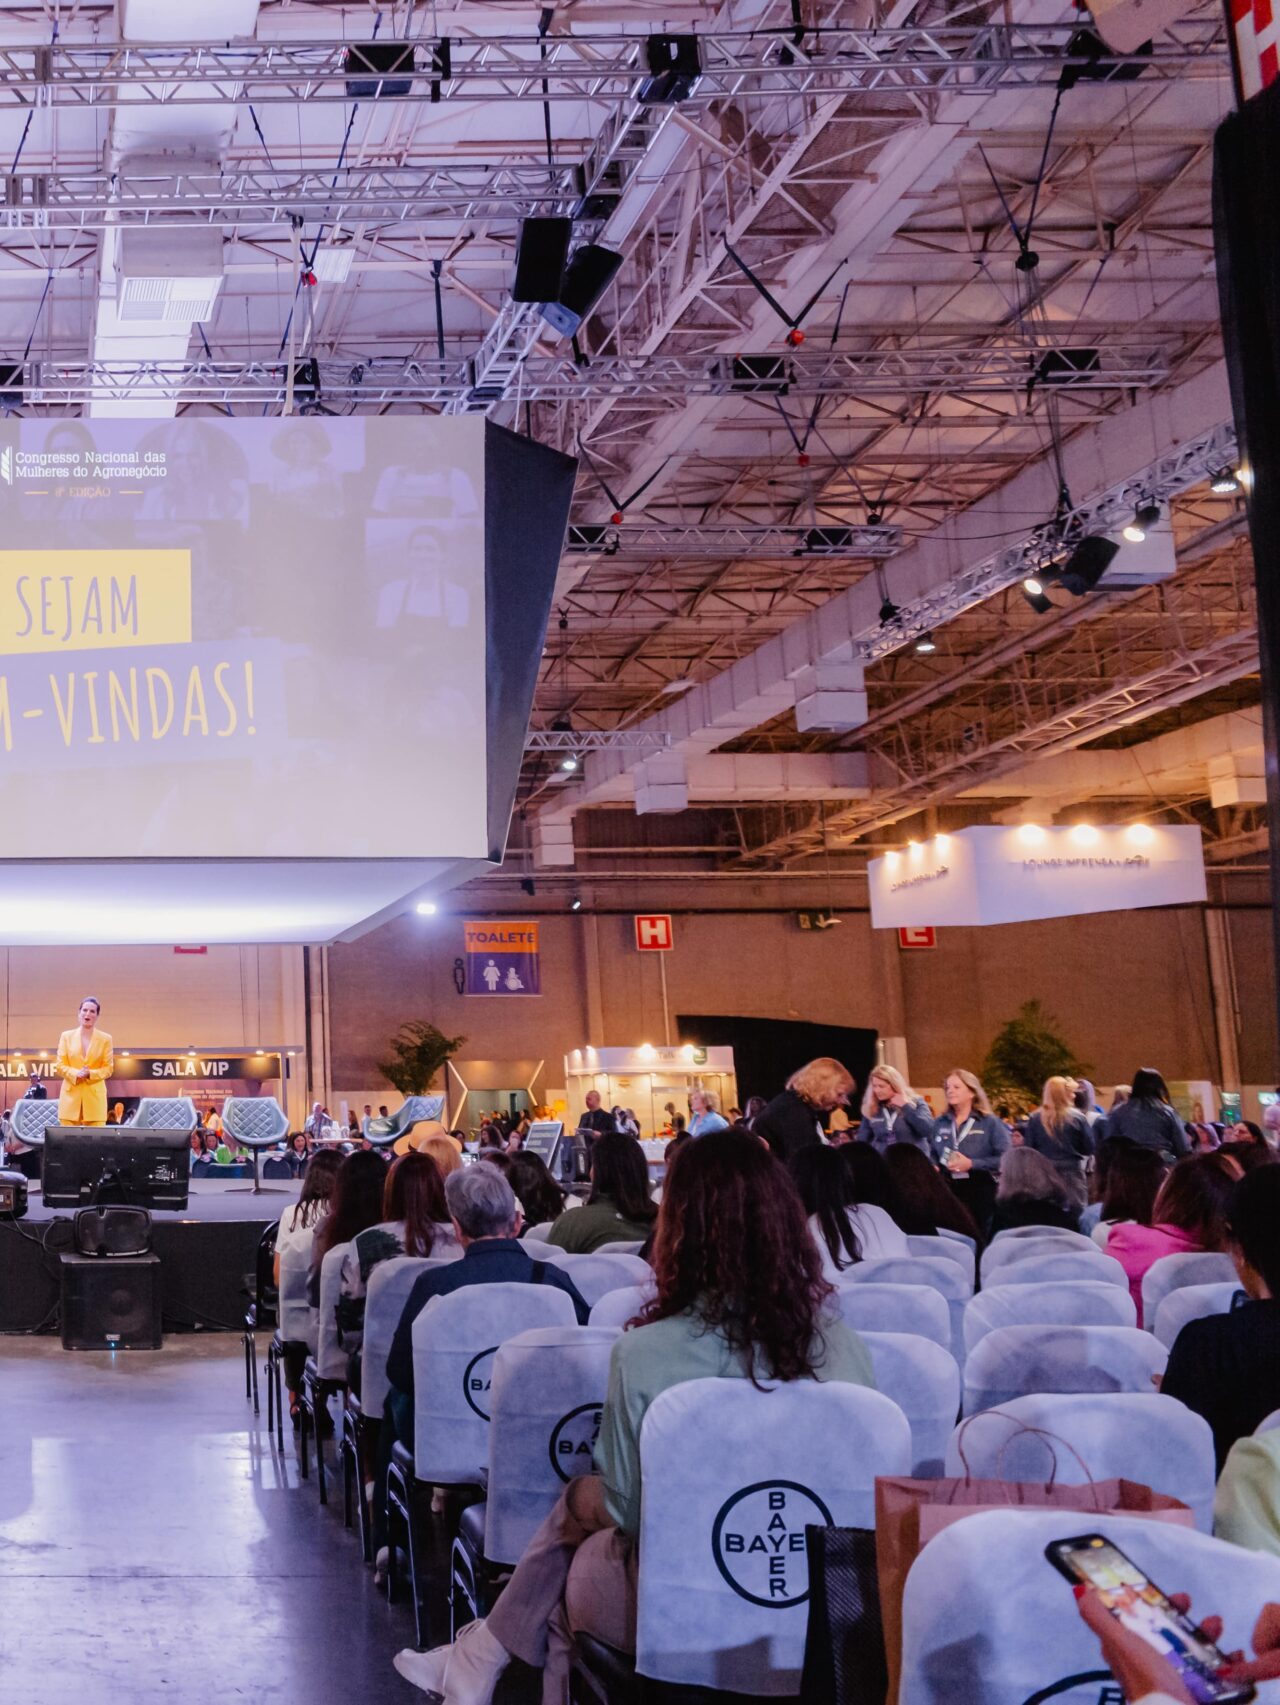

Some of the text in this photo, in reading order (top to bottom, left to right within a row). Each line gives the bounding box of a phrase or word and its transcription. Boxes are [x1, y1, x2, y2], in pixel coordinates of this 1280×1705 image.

[15, 451, 166, 466] Congresso Nacional das
[15, 465, 167, 479] Mulheres do Agronegócio
[69, 485, 111, 499] EDIÇÃO
[16, 574, 139, 641] SEJAM
[466, 931, 535, 944] TOALETE
[640, 919, 667, 945] H
[152, 1061, 230, 1077] SALA VIP
[725, 1533, 805, 1554] BAYE
[767, 1491, 789, 1597] BAYER
